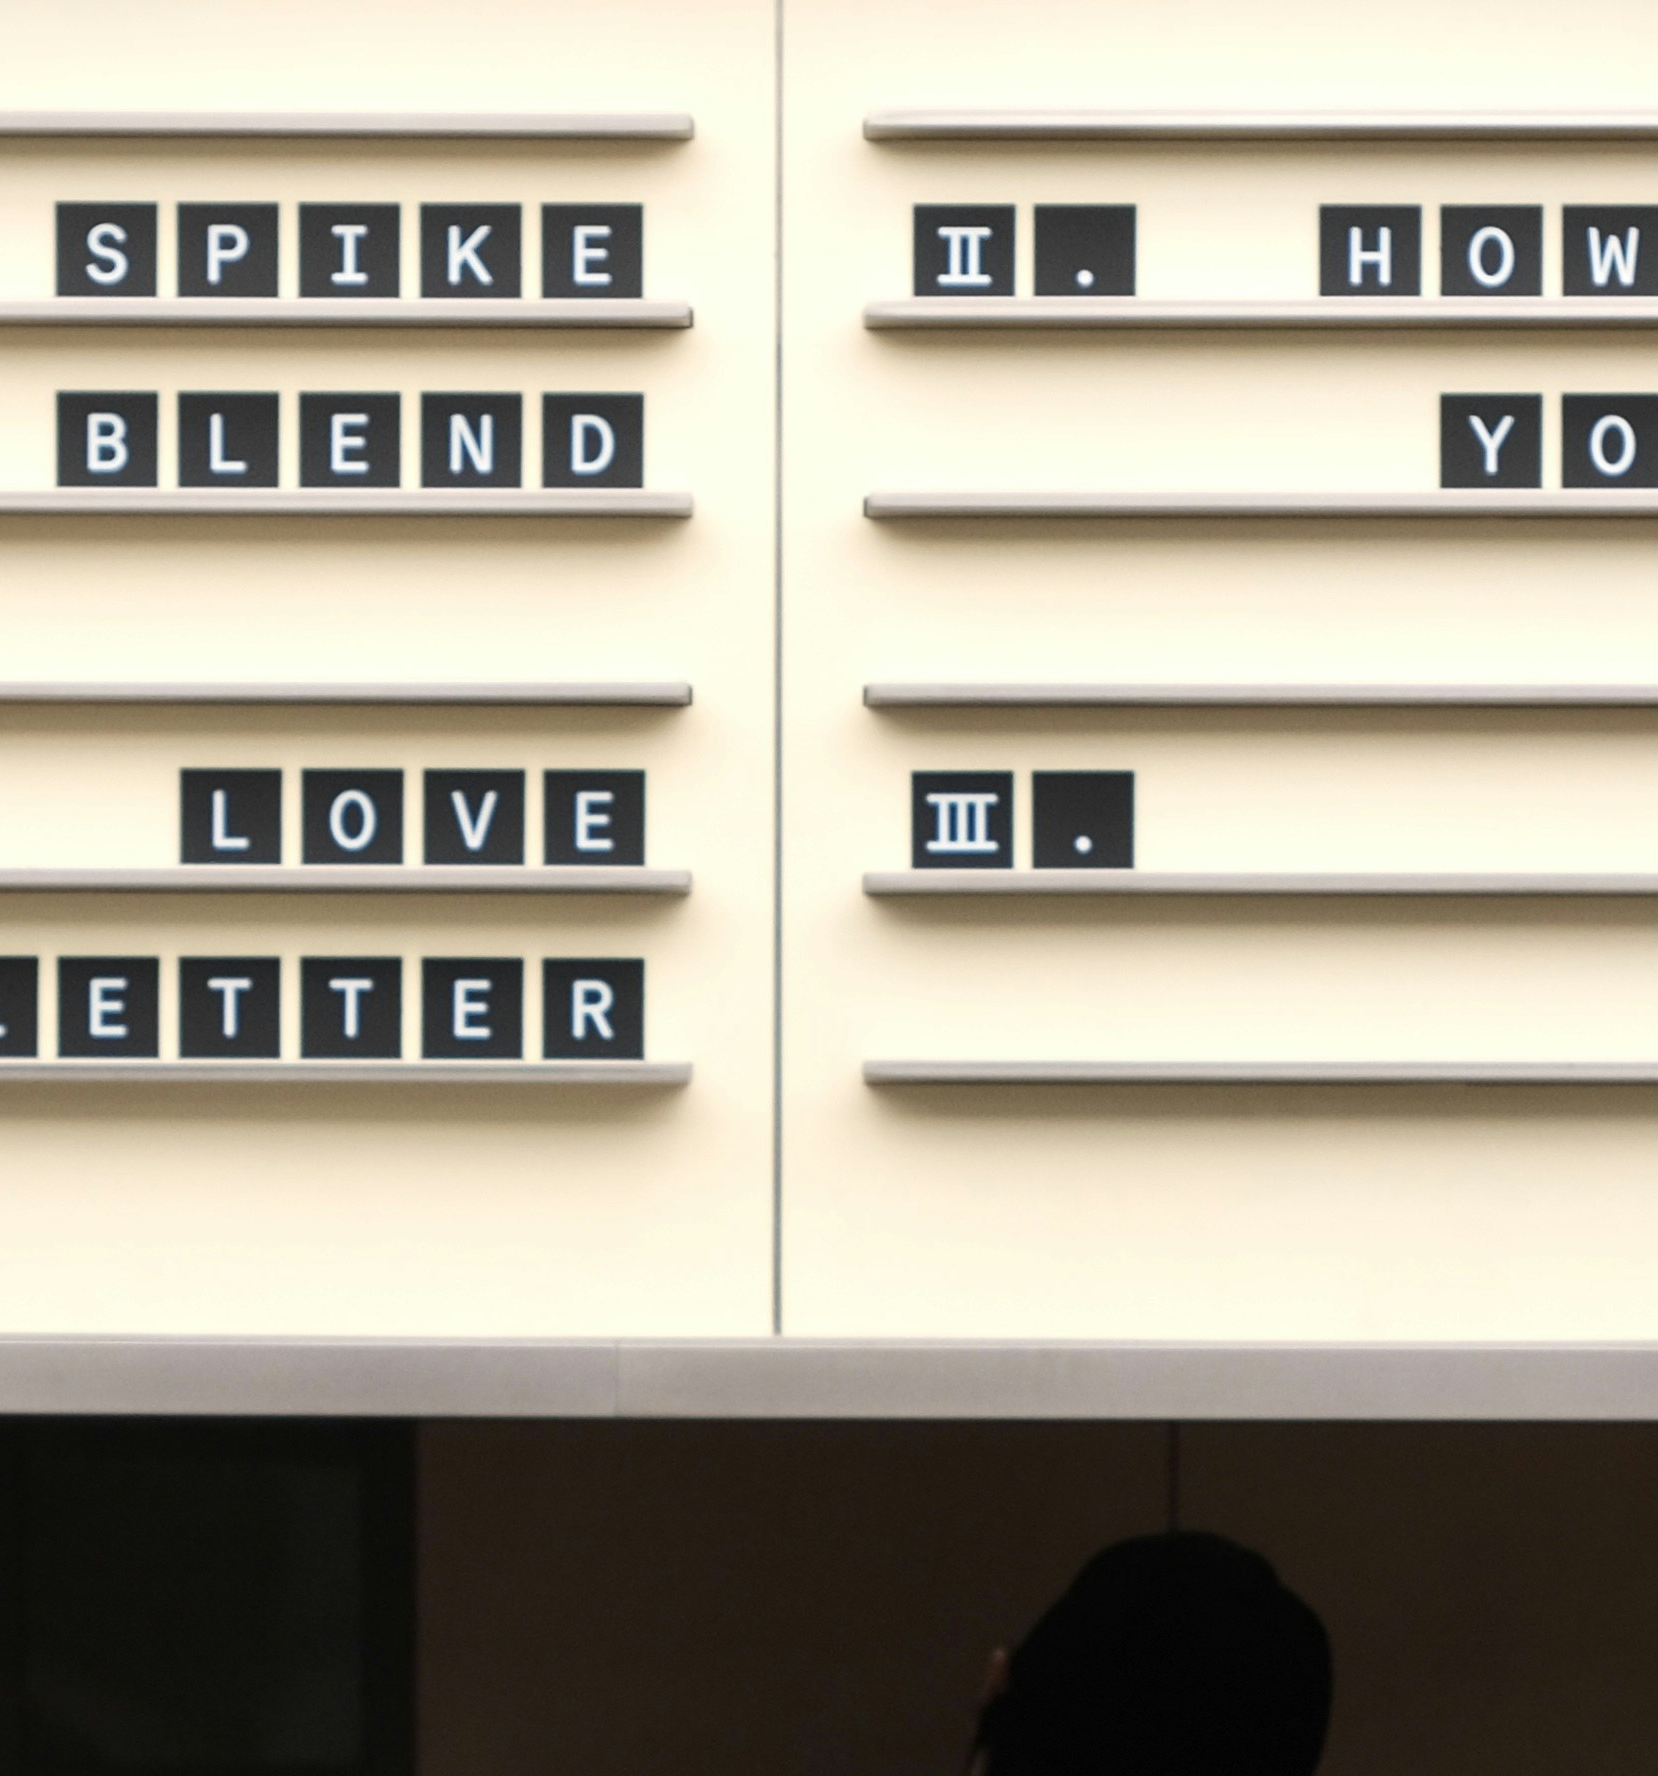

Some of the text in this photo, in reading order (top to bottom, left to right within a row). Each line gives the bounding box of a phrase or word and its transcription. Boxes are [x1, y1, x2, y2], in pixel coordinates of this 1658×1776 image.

[84, 221, 614, 287] SPIKE
[1347, 224, 1641, 289] HOW
[85, 411, 616, 476] BLEND
[211, 788, 615, 853] LOVE
